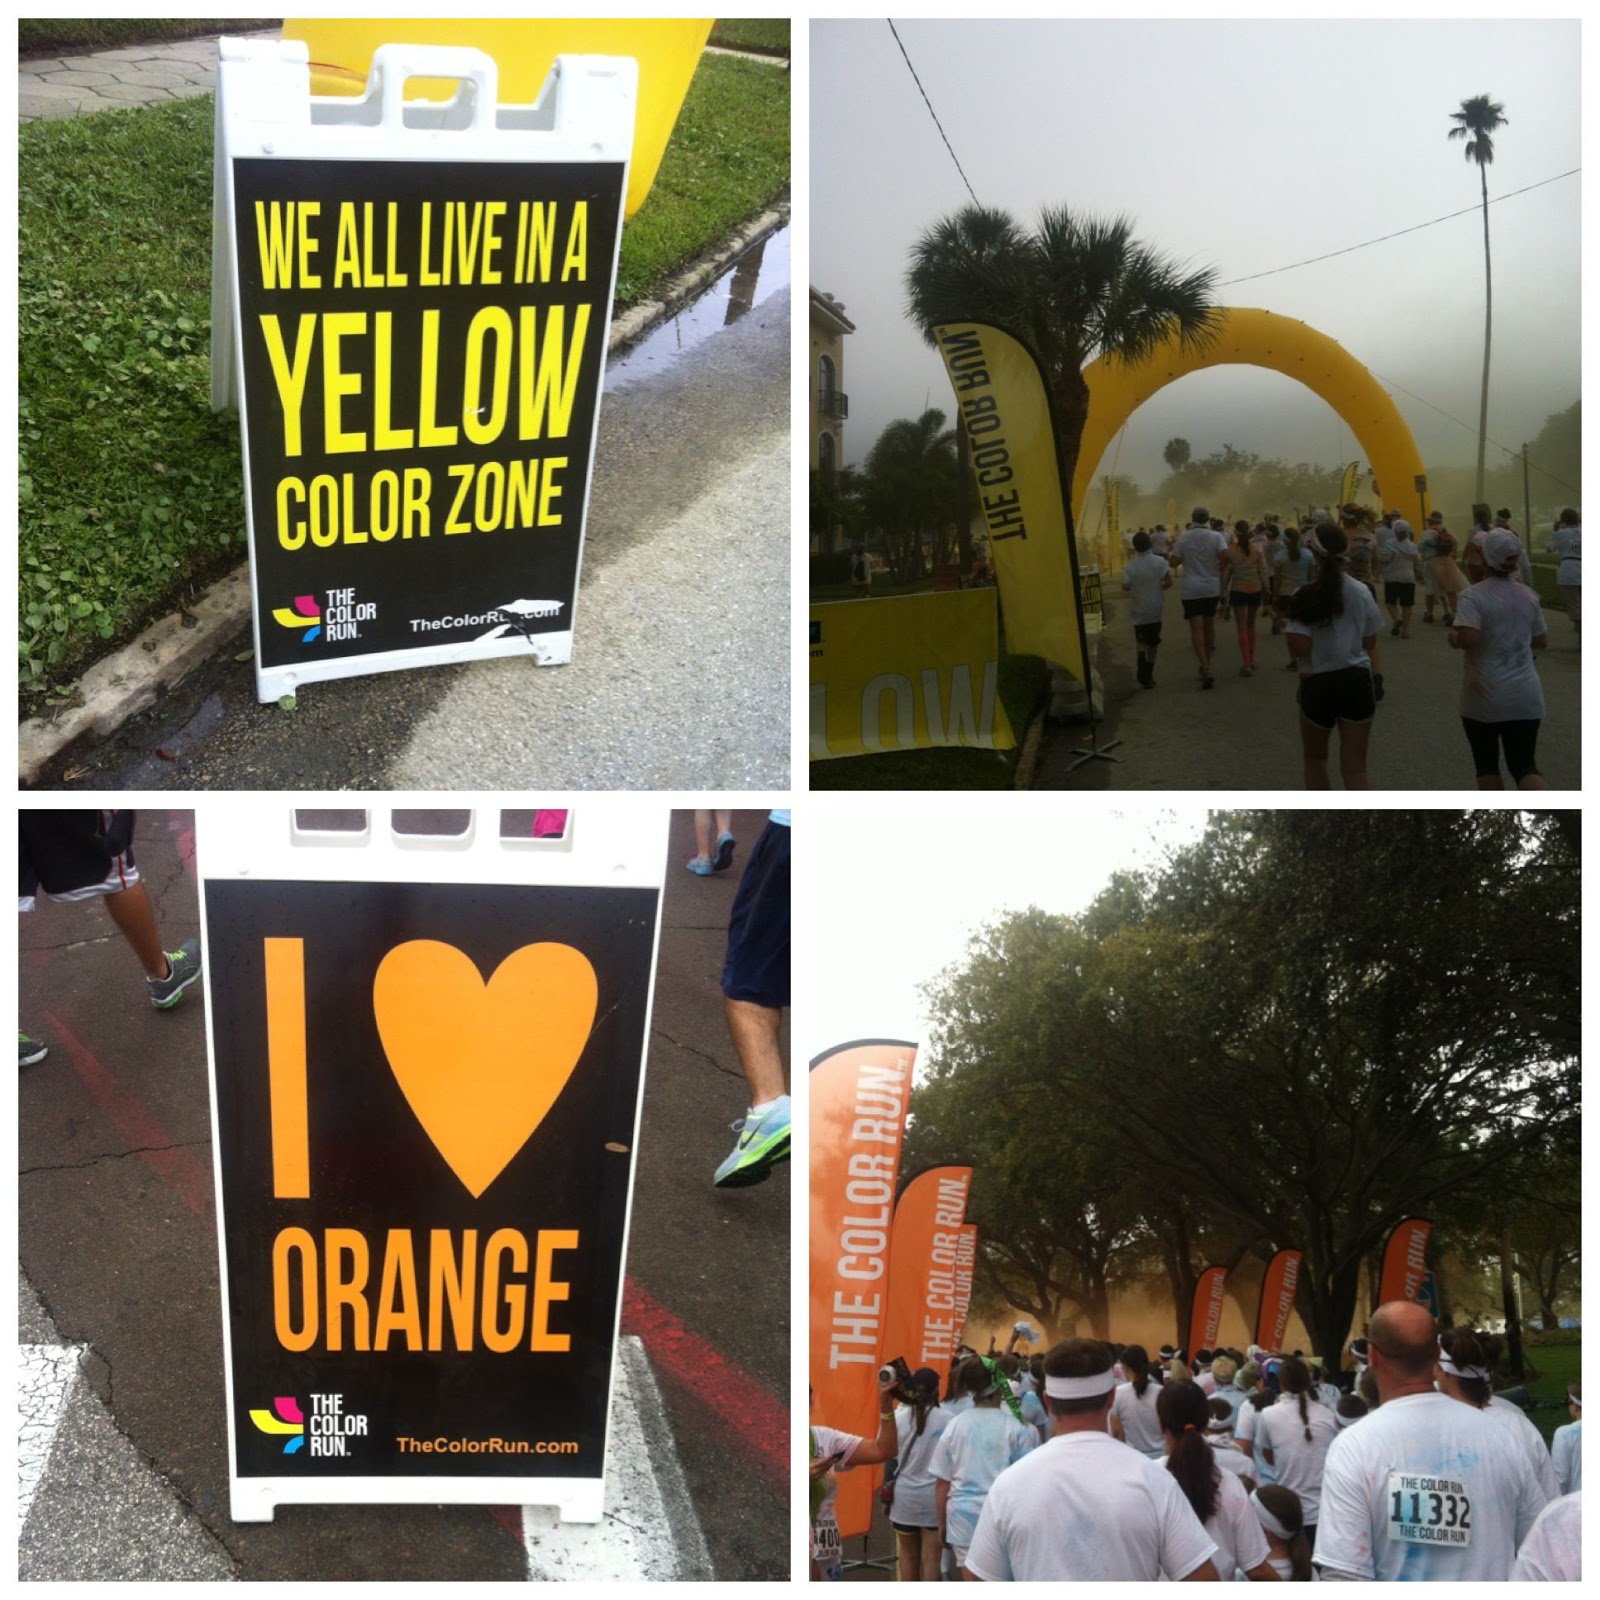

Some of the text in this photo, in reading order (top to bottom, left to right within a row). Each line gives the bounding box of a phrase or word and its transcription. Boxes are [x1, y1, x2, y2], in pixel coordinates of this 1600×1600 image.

[255, 201, 588, 289] WE ALL LIVE IN A
[259, 303, 592, 457] YELLOW
[276, 456, 568, 551] COLOR ZONE
[326, 588, 355, 607] THE
[326, 603, 377, 624] COLOR
[264, 937, 311, 1199] I
[838, 1153, 895, 1281] COLOR
[272, 1226, 580, 1353] ORANGE
[926, 1231, 959, 1310] COLOR
[829, 1291, 881, 1369] THE
[921, 1315, 954, 1363] THE
[310, 1394, 343, 1415] THE
[310, 1415, 368, 1436] COLOR
[396, 1437, 579, 1454] TheColorRun.com
[1391, 1490, 1471, 1529] 11332
[1401, 1477, 1464, 1495] THE COLOR RUN
[1399, 1524, 1466, 1543] THE COLOR RUN
